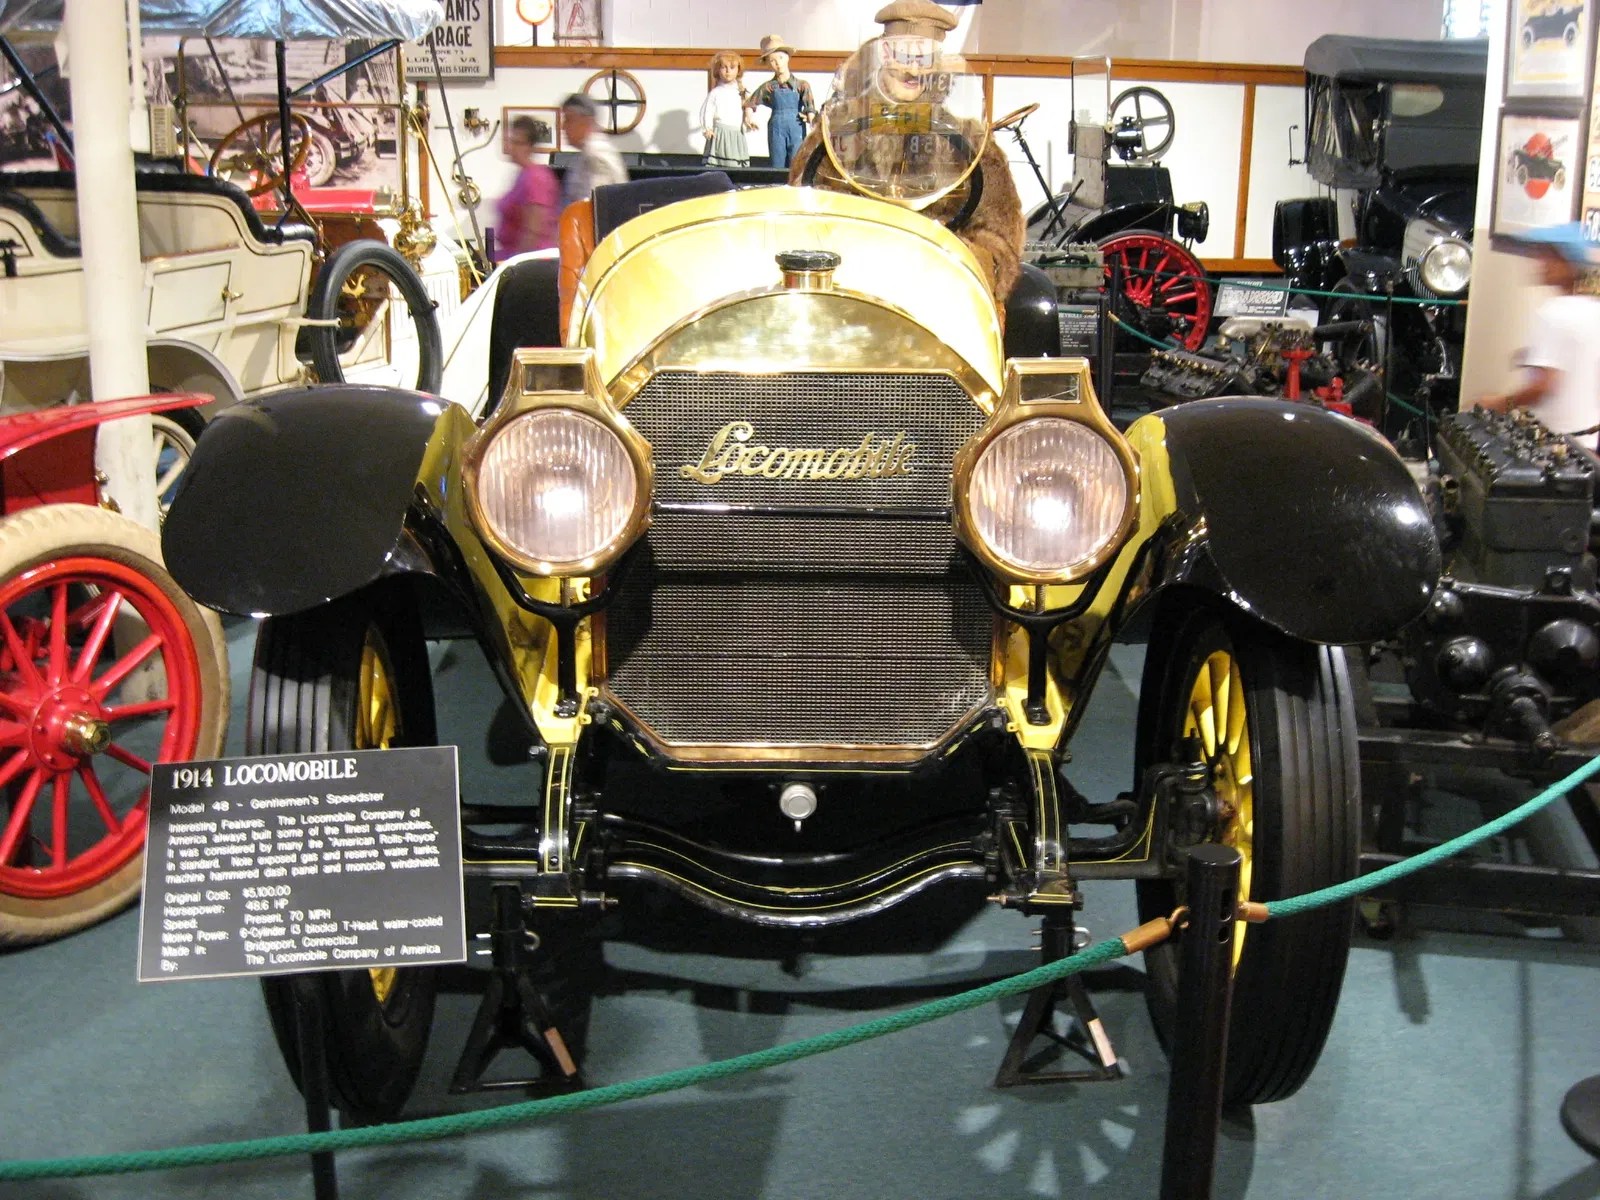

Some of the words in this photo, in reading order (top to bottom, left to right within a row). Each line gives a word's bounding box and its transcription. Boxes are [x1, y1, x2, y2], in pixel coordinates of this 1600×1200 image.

[680, 421, 915, 484] Locomobile
[172, 767, 213, 789] 1914
[223, 758, 358, 786] LOCOMOBILE
[170, 803, 205, 814] Model
[212, 801, 229, 812] 48
[250, 794, 319, 810] Gentlemen's
[326, 792, 385, 805] Speedster
[168, 820, 217, 834] Interesting
[221, 818, 266, 830] Features:
[277, 815, 296, 826] The
[301, 811, 356, 824] Locomobile
[360, 810, 405, 821] Company
[410, 807, 421, 818] of
[168, 834, 207, 846] America
[212, 831, 247, 844] always
[251, 829, 272, 841] built
[276, 828, 304, 839] some
[308, 826, 319, 837] of
[323, 825, 340, 836] the
[344, 823, 370, 834] finest
[375, 820, 434, 833] automobiles.
[167, 848, 175, 859] It
[179, 847, 200, 858] was
[204, 843, 255, 857] considered
[259, 842, 273, 854] by
[276, 840, 304, 852] many
[308, 838, 324, 849] the
[180, 857, 221, 871] standard.
[231, 856, 253, 867] Note
[257, 853, 297, 866] exposed
[300, 852, 319, 864] gas
[323, 850, 341, 861] and
[344, 848, 379, 860] reserve
[383, 847, 409, 857] water
[166, 873, 206, 884] machine
[210, 868, 260, 881] hammered
[263, 866, 288, 878] dash
[291, 863, 319, 877] panel
[323, 863, 342, 874] and
[345, 860, 386, 872] monocle
[390, 857, 440, 869] windshield.
[163, 904, 225, 917] Horsepower:
[273, 898, 289, 909] HP
[164, 892, 202, 905] Original
[205, 890, 231, 902] Cost:
[242, 885, 291, 898] $5,100.00
[162, 932, 194, 945] Motive
[196, 930, 229, 942] Power:
[239, 926, 286, 939] 6-Cylinder
[383, 915, 444, 929] water-cooled
[163, 919, 198, 931] Speed:
[288, 910, 304, 921] 70
[308, 908, 331, 920] MPH
[160, 959, 179, 973] By:
[245, 953, 265, 965] The
[269, 949, 328, 964] Locomobile
[332, 947, 379, 960] Company
[383, 945, 395, 957] of
[400, 943, 441, 956] America
[161, 945, 190, 957] Made
[302, 935, 358, 948] Connecticut
